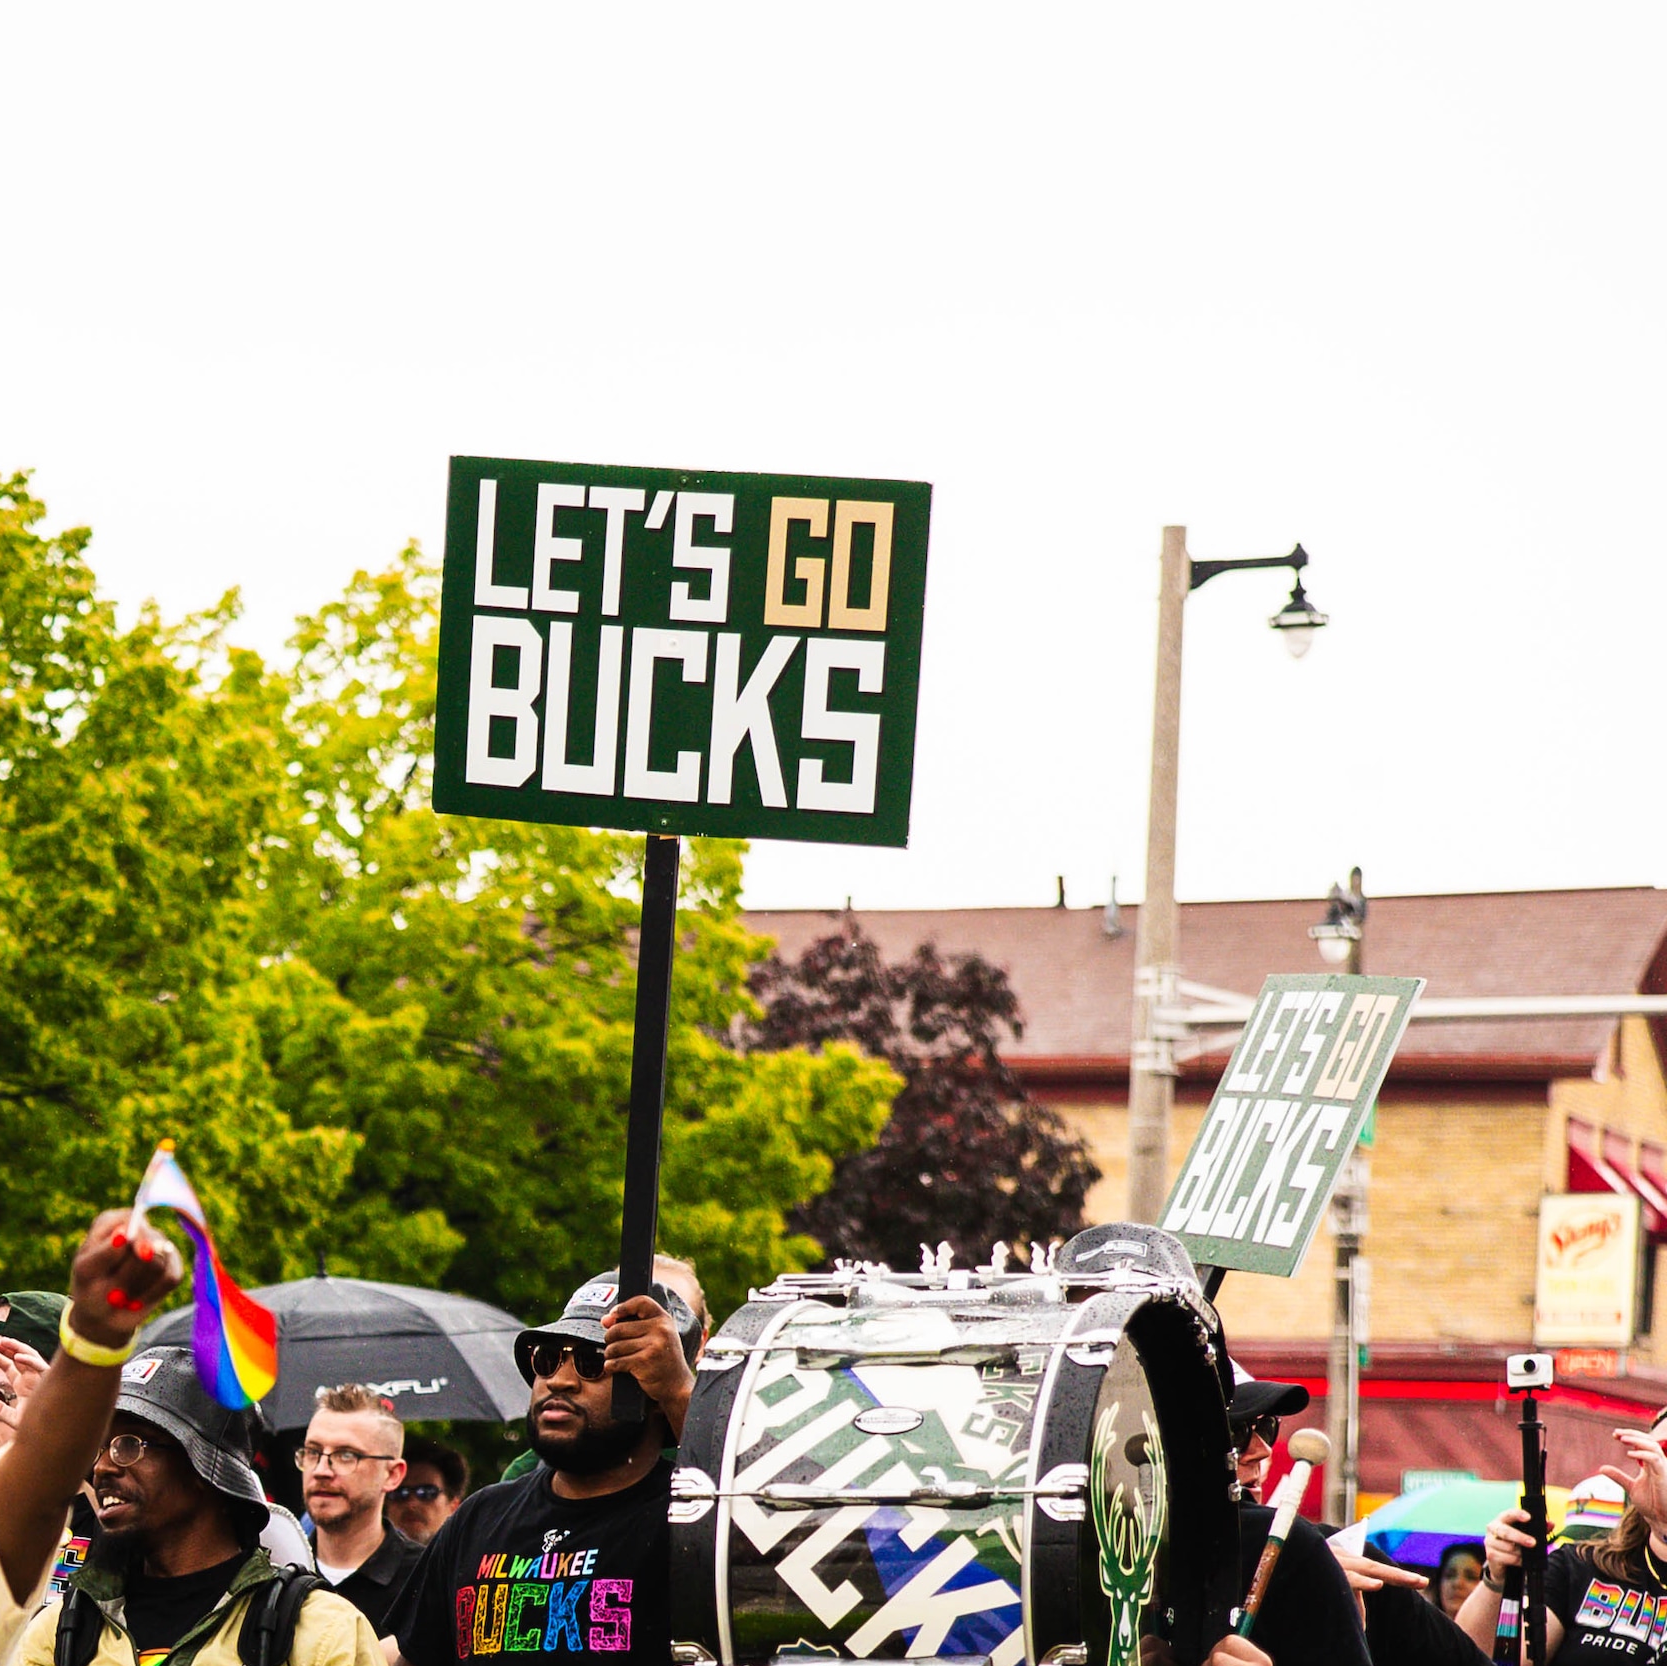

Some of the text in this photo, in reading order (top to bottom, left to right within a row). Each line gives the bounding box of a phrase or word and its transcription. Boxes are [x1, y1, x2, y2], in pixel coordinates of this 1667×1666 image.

[474, 478, 895, 632] LET'S GO
[465, 614, 887, 814] BUCKS
[1224, 990, 1400, 1101] LET'S GO
[1160, 1096, 1352, 1249] BUCKS
[455, 1578, 634, 1660] BUCKS
[476, 1549, 599, 1579] MILWAUKEE
[1581, 1632, 1639, 1656] PRIDE
